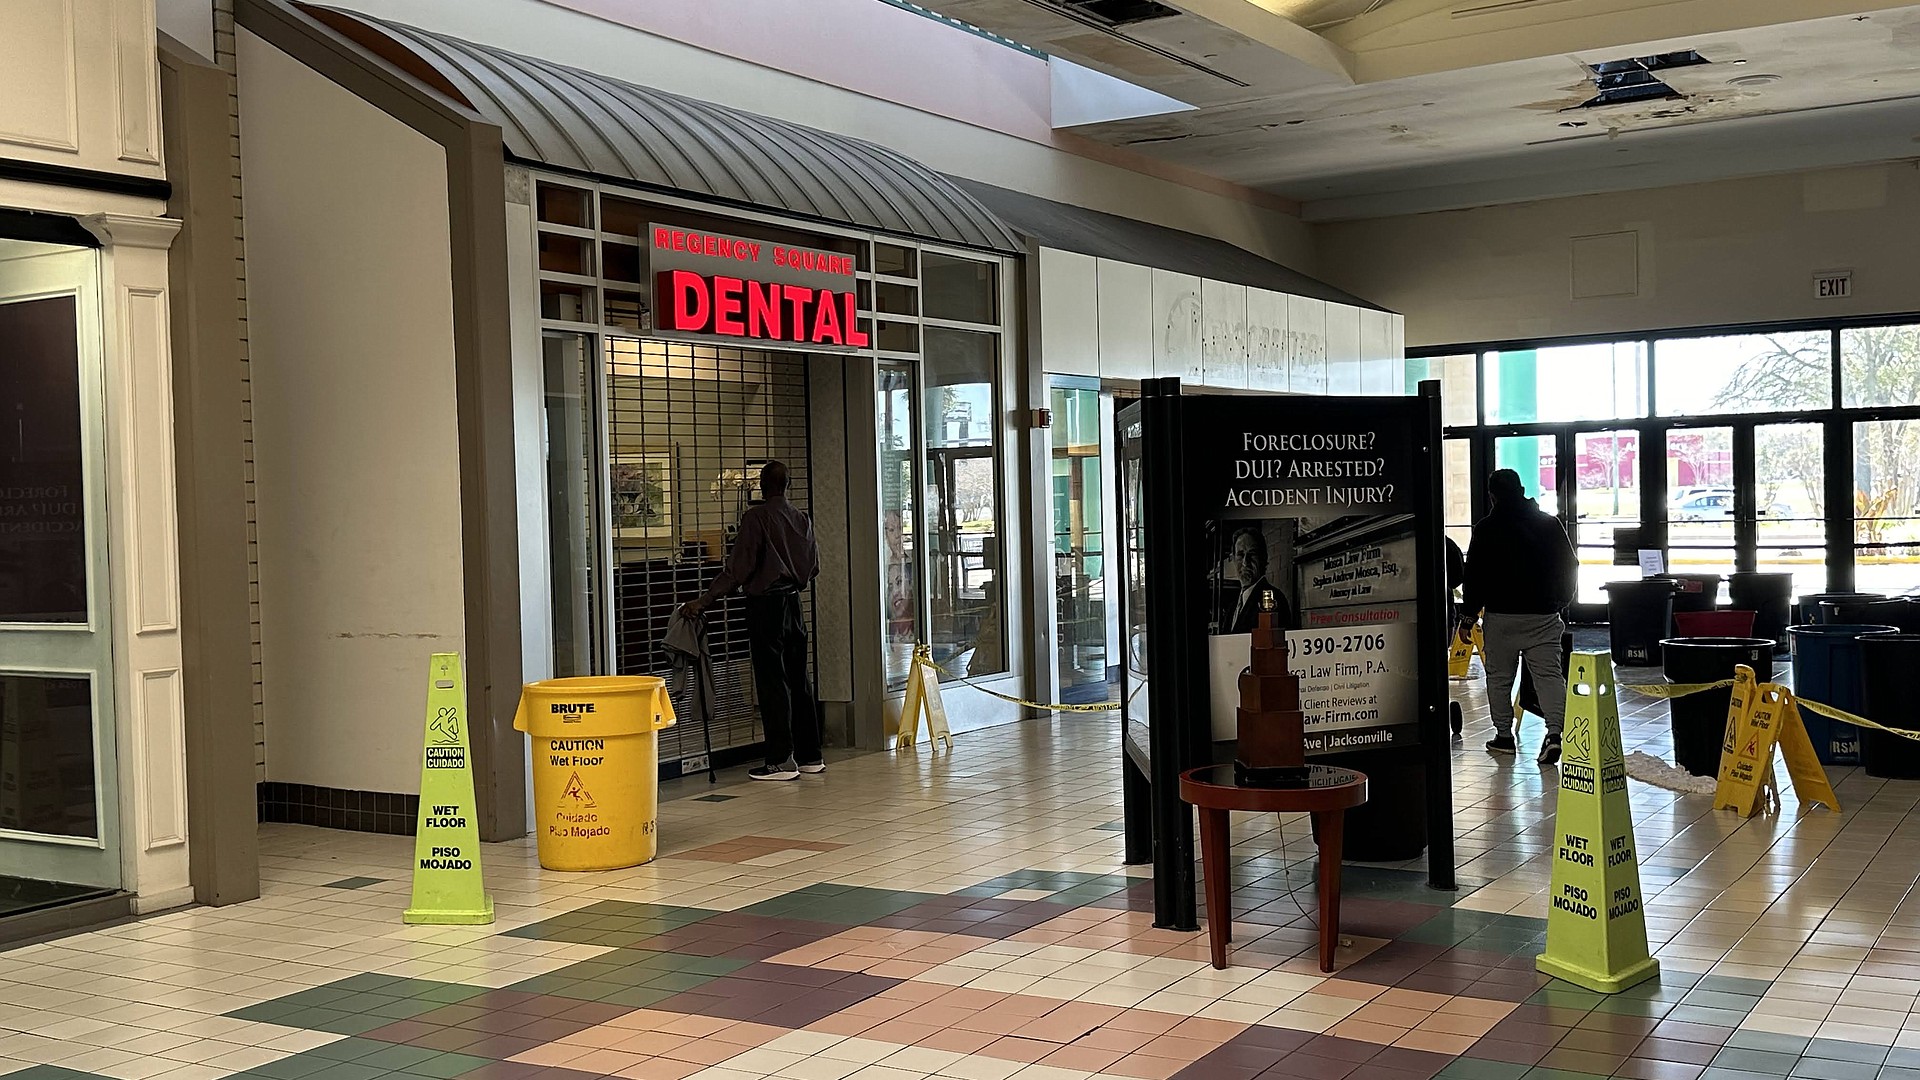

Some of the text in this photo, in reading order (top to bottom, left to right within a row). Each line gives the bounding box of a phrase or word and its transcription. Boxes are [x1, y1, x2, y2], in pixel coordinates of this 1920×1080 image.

[654, 227, 853, 276] REGENCY SQUARE
[1820, 278, 1847, 297] EXIT
[669, 270, 868, 347] DENTAL
[1243, 431, 1376, 451] FORECLOSURE?
[1235, 458, 1385, 479] DUI? ARRESTED?
[1225, 484, 1394, 508] ACCIDENT INJURY?
[1344, 552, 1360, 565] Law
[1361, 546, 1382, 562] Firm
[1381, 561, 1399, 576] Esq.
[1335, 608, 1400, 623] Consultation
[1303, 634, 1385, 656] 390-2706
[1311, 665, 1331, 678] Law
[1335, 662, 1362, 677] Firm,
[1366, 660, 1390, 674] P.A.
[551, 703, 595, 714] BRUTE
[1304, 698, 1329, 710] Client
[1332, 696, 1367, 707] Reviews
[1369, 695, 1378, 704] at
[1304, 709, 1379, 725] aw-Firm.com
[550, 740, 604, 751] CAUTION
[1329, 730, 1393, 748] Jacksonville
[1832, 741, 1858, 753] RSM
[427, 748, 464, 757] CAUTION
[427, 759, 464, 768] CUIDADO
[550, 756, 604, 766] Wet Floor
[1563, 764, 1594, 780] CAUTION
[1562, 777, 1594, 793] CUIDADO
[433, 806, 459, 815] WET
[426, 818, 466, 828] FLOOR
[571, 826, 610, 839] Mojado
[1566, 834, 1589, 851] WET
[1610, 836, 1626, 851] WET
[432, 847, 460, 857] PISO
[1559, 848, 1594, 867] FLOOR
[1608, 849, 1632, 868] FLOOR
[420, 860, 471, 870] MOJADO
[1563, 884, 1588, 902] PISO
[1613, 886, 1631, 903] PISO
[1553, 896, 1597, 920] MOJADO
[1609, 899, 1639, 921] MOJADO
